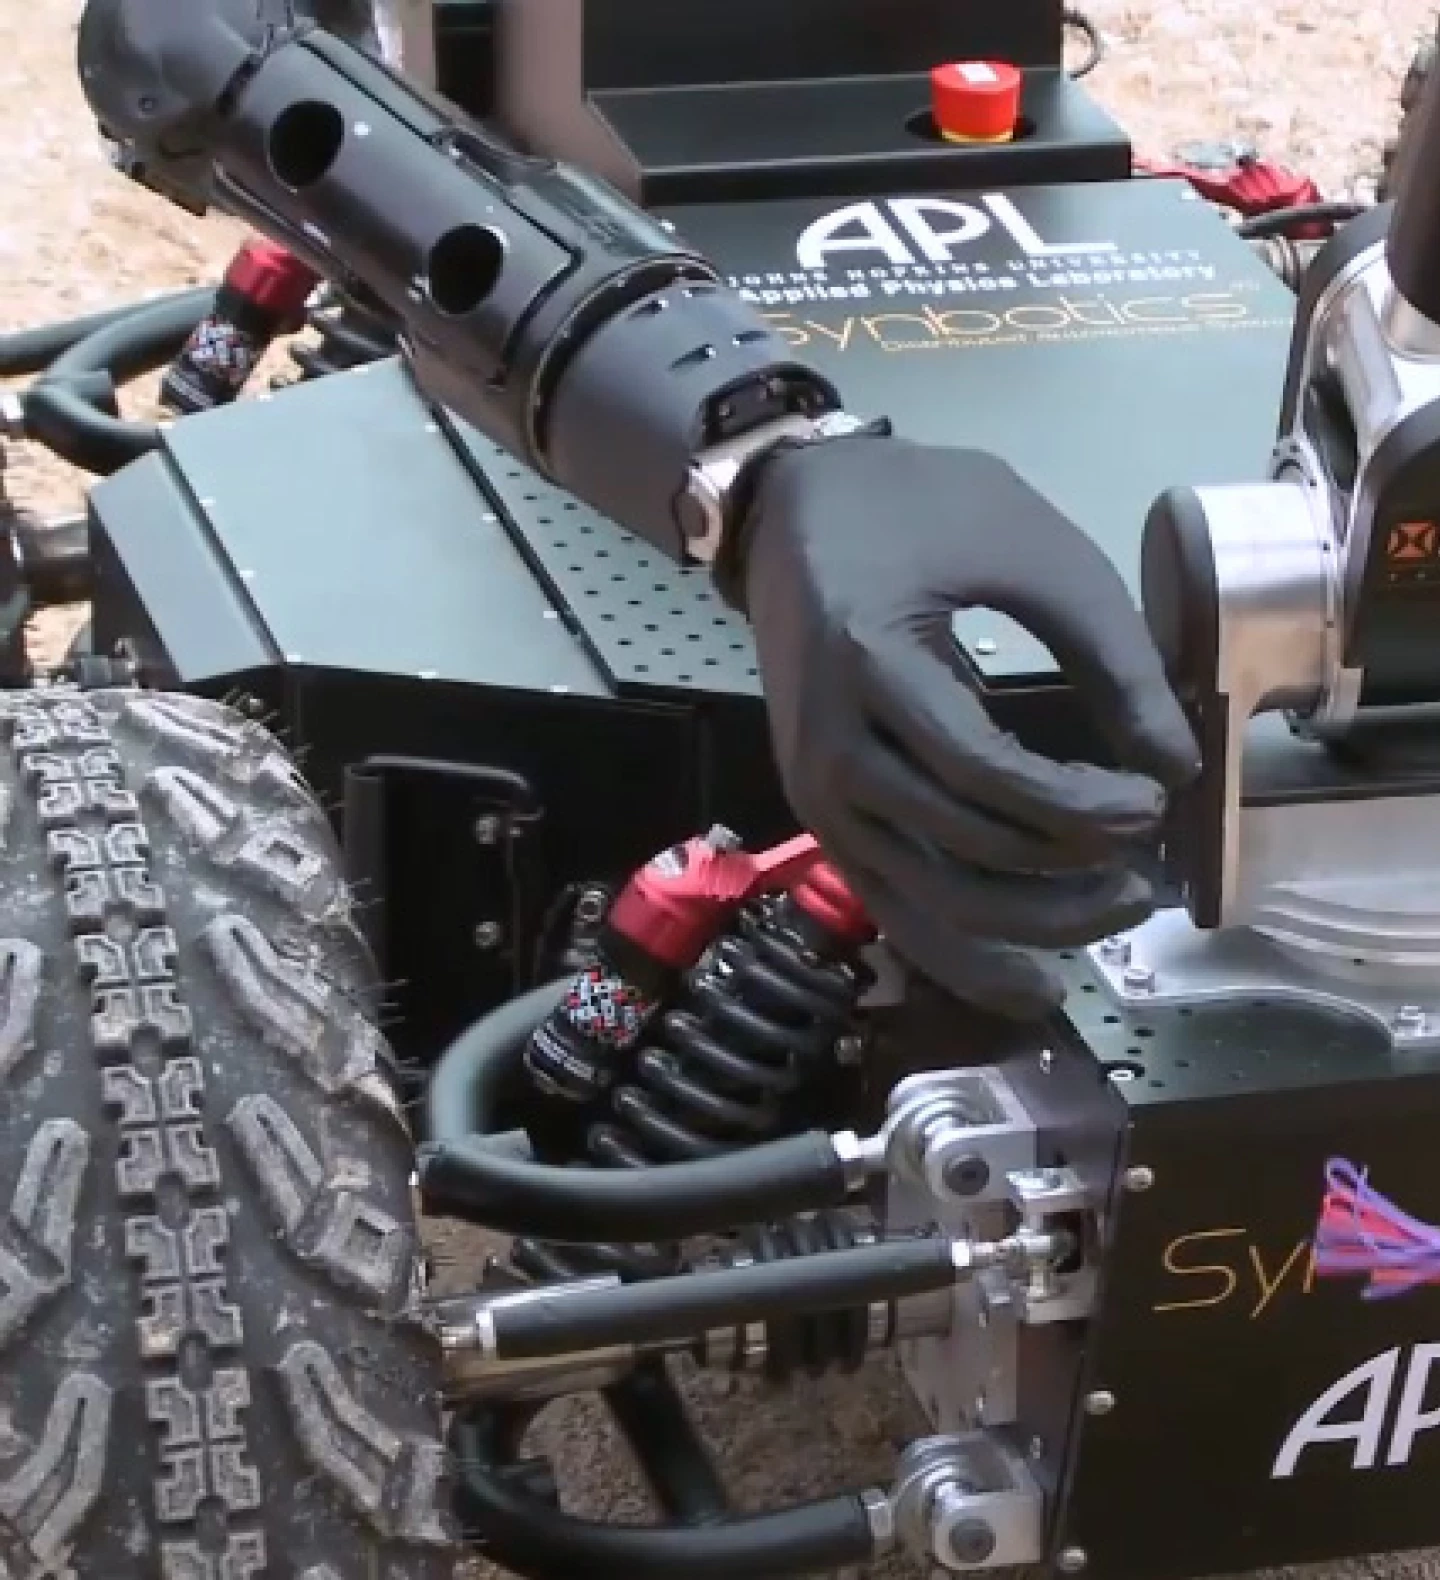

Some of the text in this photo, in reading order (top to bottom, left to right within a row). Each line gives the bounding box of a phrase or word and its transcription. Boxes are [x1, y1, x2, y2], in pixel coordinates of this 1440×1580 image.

[795, 192, 1118, 268] APL
[739, 280, 872, 304] Applied
[880, 273, 1018, 295] Physics
[1026, 264, 1217, 289] Laboratory
[847, 261, 991, 281] HOPKINS
[1005, 249, 1201, 272] UNIVERSITY
